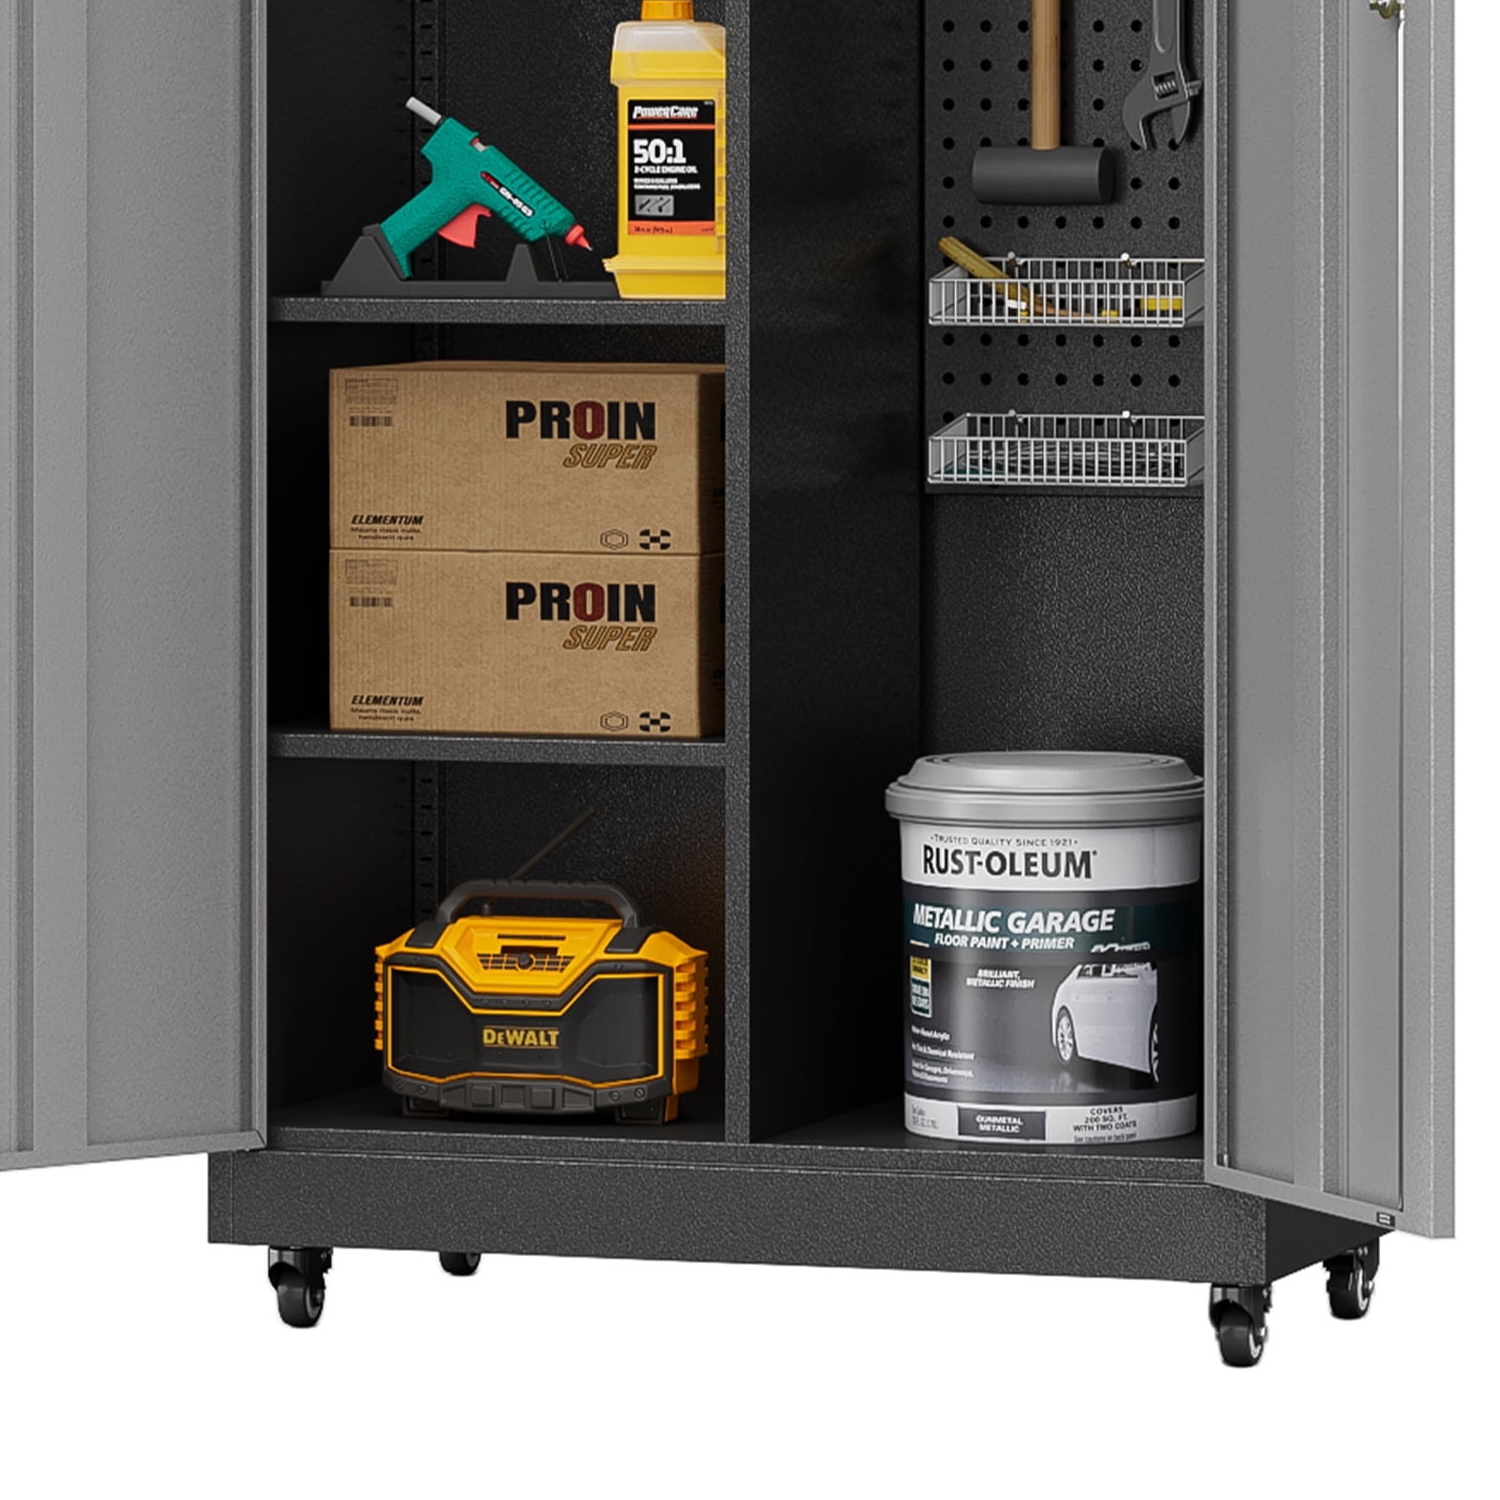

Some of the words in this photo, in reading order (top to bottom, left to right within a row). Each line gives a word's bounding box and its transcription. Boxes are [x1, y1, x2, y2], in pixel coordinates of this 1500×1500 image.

[633, 138, 687, 164] 50:1
[505, 400, 656, 440] PROIN
[562, 443, 658, 470] SUPER
[351, 514, 424, 526] ELEMENTUM
[505, 581, 656, 622] PROIN
[562, 625, 658, 652] SUPER
[351, 694, 424, 707] ELEMENTUM
[971, 836, 1011, 846] QUALITY
[1015, 838, 1046, 847] SINCE
[913, 903, 1002, 933] METALLIC
[1007, 909, 1116, 934] GARAGE
[934, 932, 968, 947] FLOOR
[969, 935, 1005, 949] PAINT
[1021, 937, 1075, 950] PRIMER
[1090, 1106, 1123, 1115] COVERS
[976, 1115, 1024, 1125] GUNMETAL
[979, 1124, 1020, 1133] METALLIC
